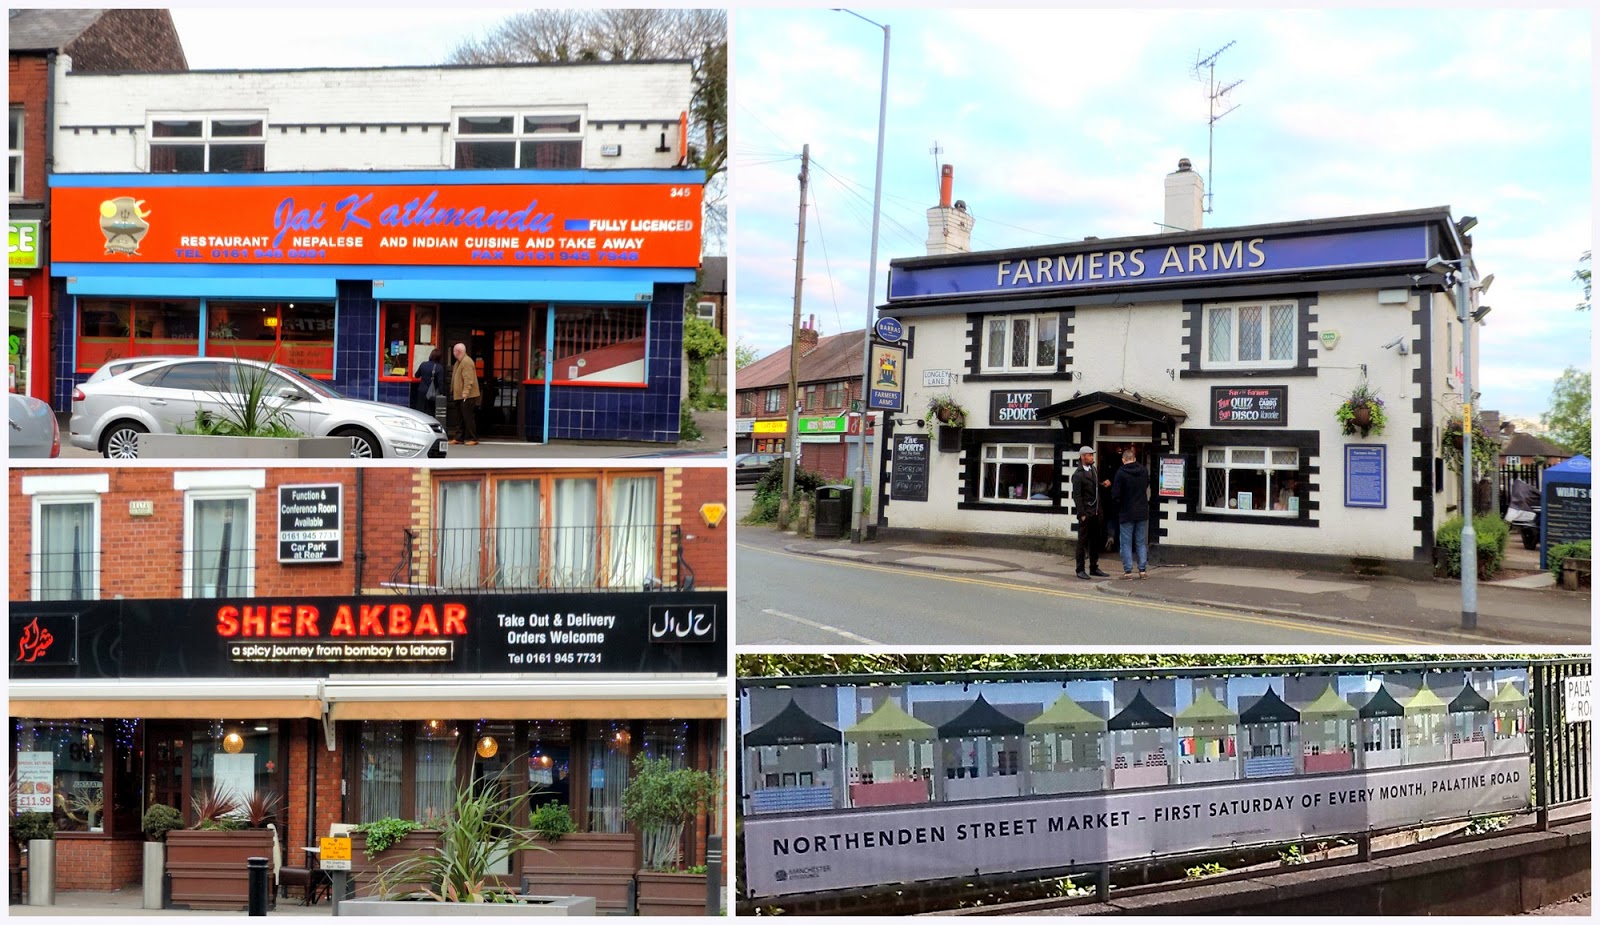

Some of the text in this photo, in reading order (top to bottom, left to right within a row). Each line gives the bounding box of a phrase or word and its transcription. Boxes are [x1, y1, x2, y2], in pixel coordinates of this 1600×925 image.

[670, 188, 691, 197] 345
[272, 197, 327, 248] Jai
[589, 220, 693, 231] FULLY LICENCED
[180, 236, 645, 249] RESTAURANT NEPALESE AND INDIAN CUISINE AND TAKE AWAY
[175, 249, 204, 258] TEL
[211, 249, 248, 258] 0161
[471, 250, 504, 260] FAX
[514, 251, 555, 260] 0161
[997, 238, 1266, 286] FARMERS ARMS
[879, 325, 901, 333] BARRAS
[924, 371, 949, 379] LONGLEY
[874, 391, 898, 399] FARMERS
[1006, 393, 1032, 404] LIVE
[878, 398, 893, 406] ARMS
[1230, 397, 1254, 409] QUIZ
[1231, 410, 1260, 421] DISCO
[898, 443, 924, 452] SPORTS
[292, 489, 327, 501] Function &
[1556, 487, 1588, 499] WHAT'S
[281, 503, 337, 514] Conference Room
[294, 516, 324, 527] Available
[303, 532, 317, 540] 945
[290, 542, 327, 552] Car Park
[293, 551, 324, 559] at Rear
[216, 603, 468, 637] SHER AKBAR
[497, 613, 616, 629] Take Out & Delivery
[507, 631, 605, 644] Orders Welcome
[232, 644, 447, 660] a spicy journey from bombay to lahore
[508, 653, 602, 664] Tel 0161 945 7731
[20, 797, 51, 806] £11.99
[773, 827, 945, 856] NORTHENDEN
[957, 818, 1037, 840] STREET
[1049, 811, 1130, 832] MARKET
[1155, 804, 1201, 822] FIRST
[1209, 796, 1294, 817] SATURDAY
[1301, 793, 1321, 807] OF
[1329, 788, 1374, 804] EVERY
[1380, 782, 1427, 800] MONTH,
[1432, 775, 1486, 793] PALATINE
[1491, 771, 1520, 785] ROAD
